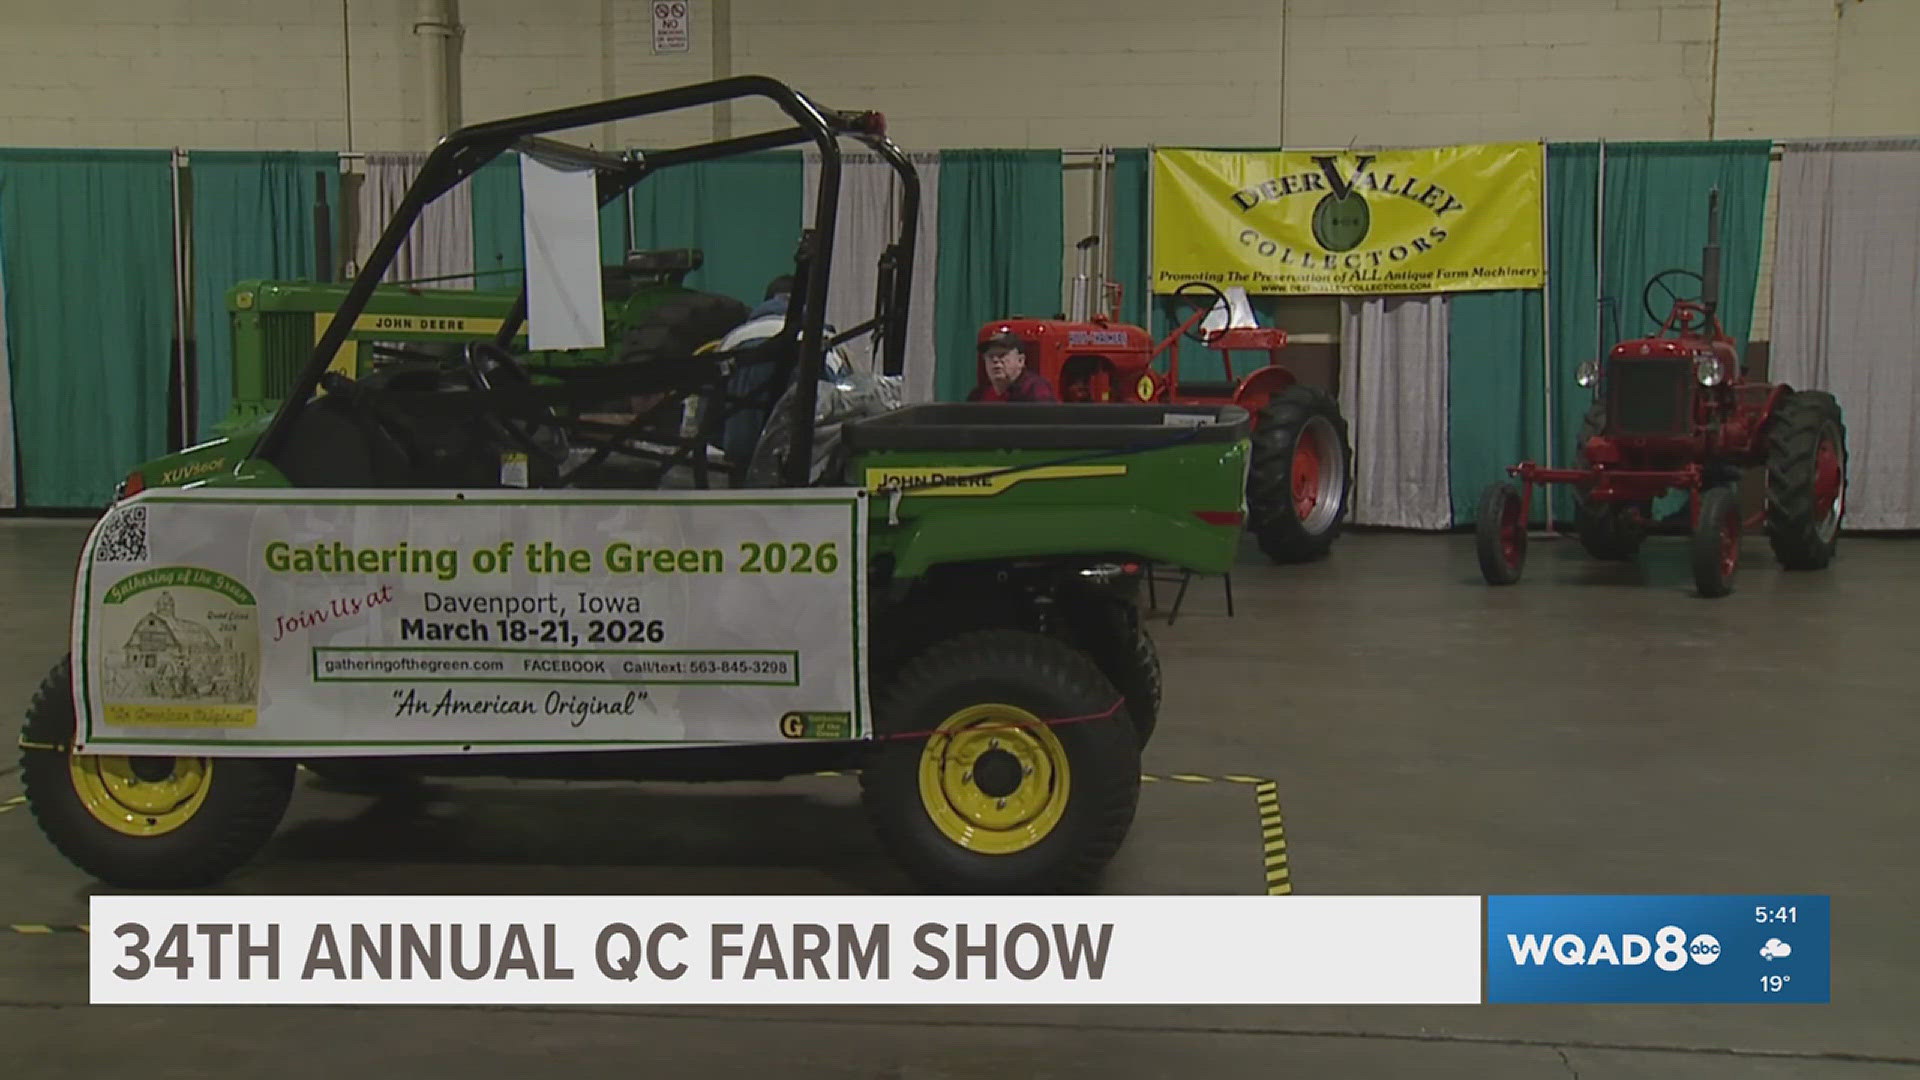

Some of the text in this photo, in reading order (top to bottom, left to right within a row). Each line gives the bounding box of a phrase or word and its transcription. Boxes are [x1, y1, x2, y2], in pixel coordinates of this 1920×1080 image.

[662, 20, 678, 28] NO
[1231, 155, 1463, 217] DEER VALLEY
[1240, 226, 1447, 269] COLLECTORS
[1160, 271, 1224, 282] Promoting
[1228, 271, 1249, 281] The
[1333, 271, 1345, 283] of
[1350, 269, 1381, 281] ALL
[1384, 270, 1433, 282] Antique
[1436, 268, 1469, 278] Farm
[1472, 266, 1539, 279] Machinery
[375, 317, 464, 330] JOHN DEERE
[265, 541, 840, 581] Gathering of the Green 2026
[177, 569, 192, 584] of
[194, 569, 213, 584] the
[273, 584, 393, 642] Join Us at
[424, 592, 641, 618] Davenport, Iowa
[400, 618, 665, 647] March 18-21, 2026
[325, 657, 504, 673] gatheringofthegreen.com
[523, 659, 606, 673] FACEBOOK
[623, 660, 687, 674] Call/text:
[432, 688, 537, 717] American
